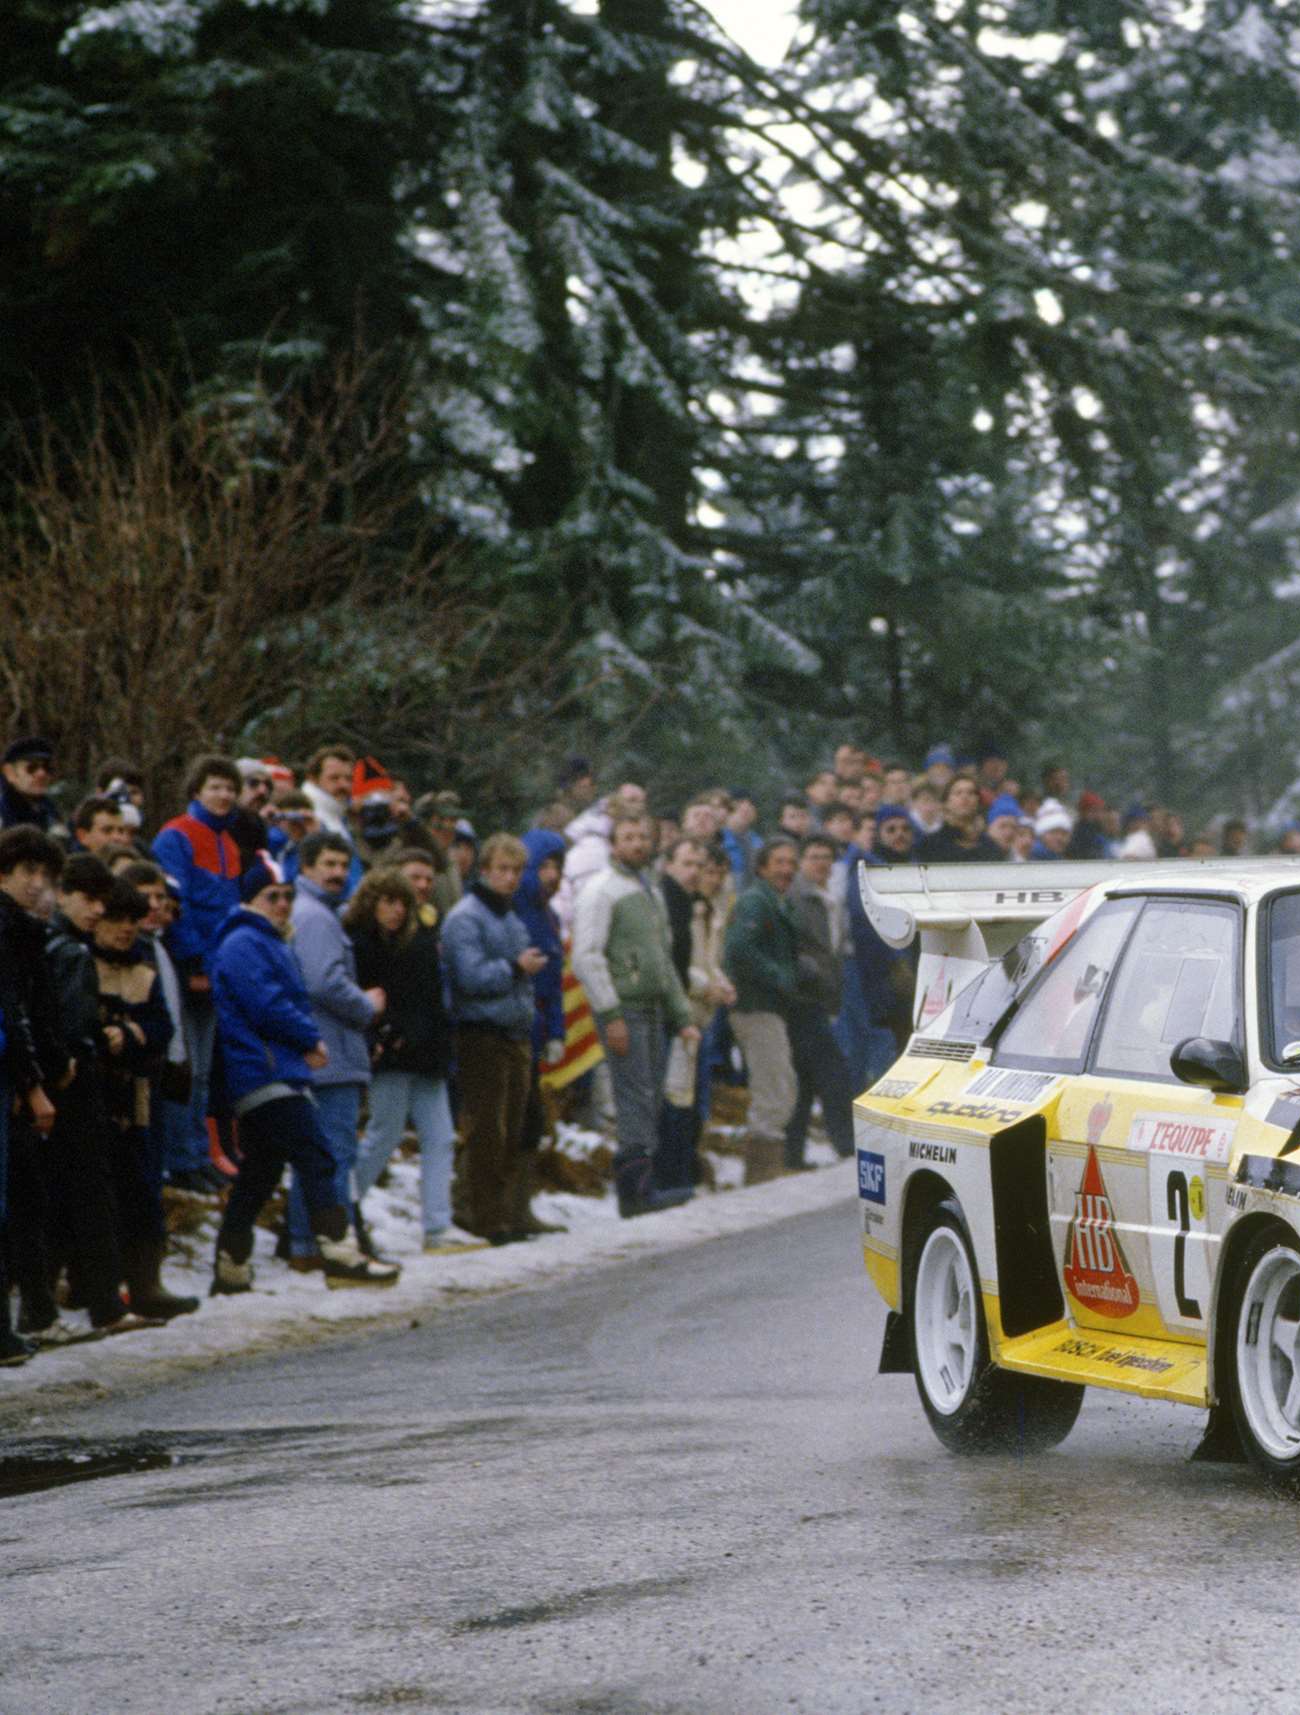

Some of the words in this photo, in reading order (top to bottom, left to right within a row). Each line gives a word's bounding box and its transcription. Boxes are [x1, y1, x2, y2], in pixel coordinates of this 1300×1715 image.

[996, 891, 1064, 904] HB
[908, 1140, 958, 1165] MICHELIN
[859, 1160, 885, 1192] SKF
[1074, 1193, 1116, 1273] HB
[1167, 1170, 1202, 1320] 2
